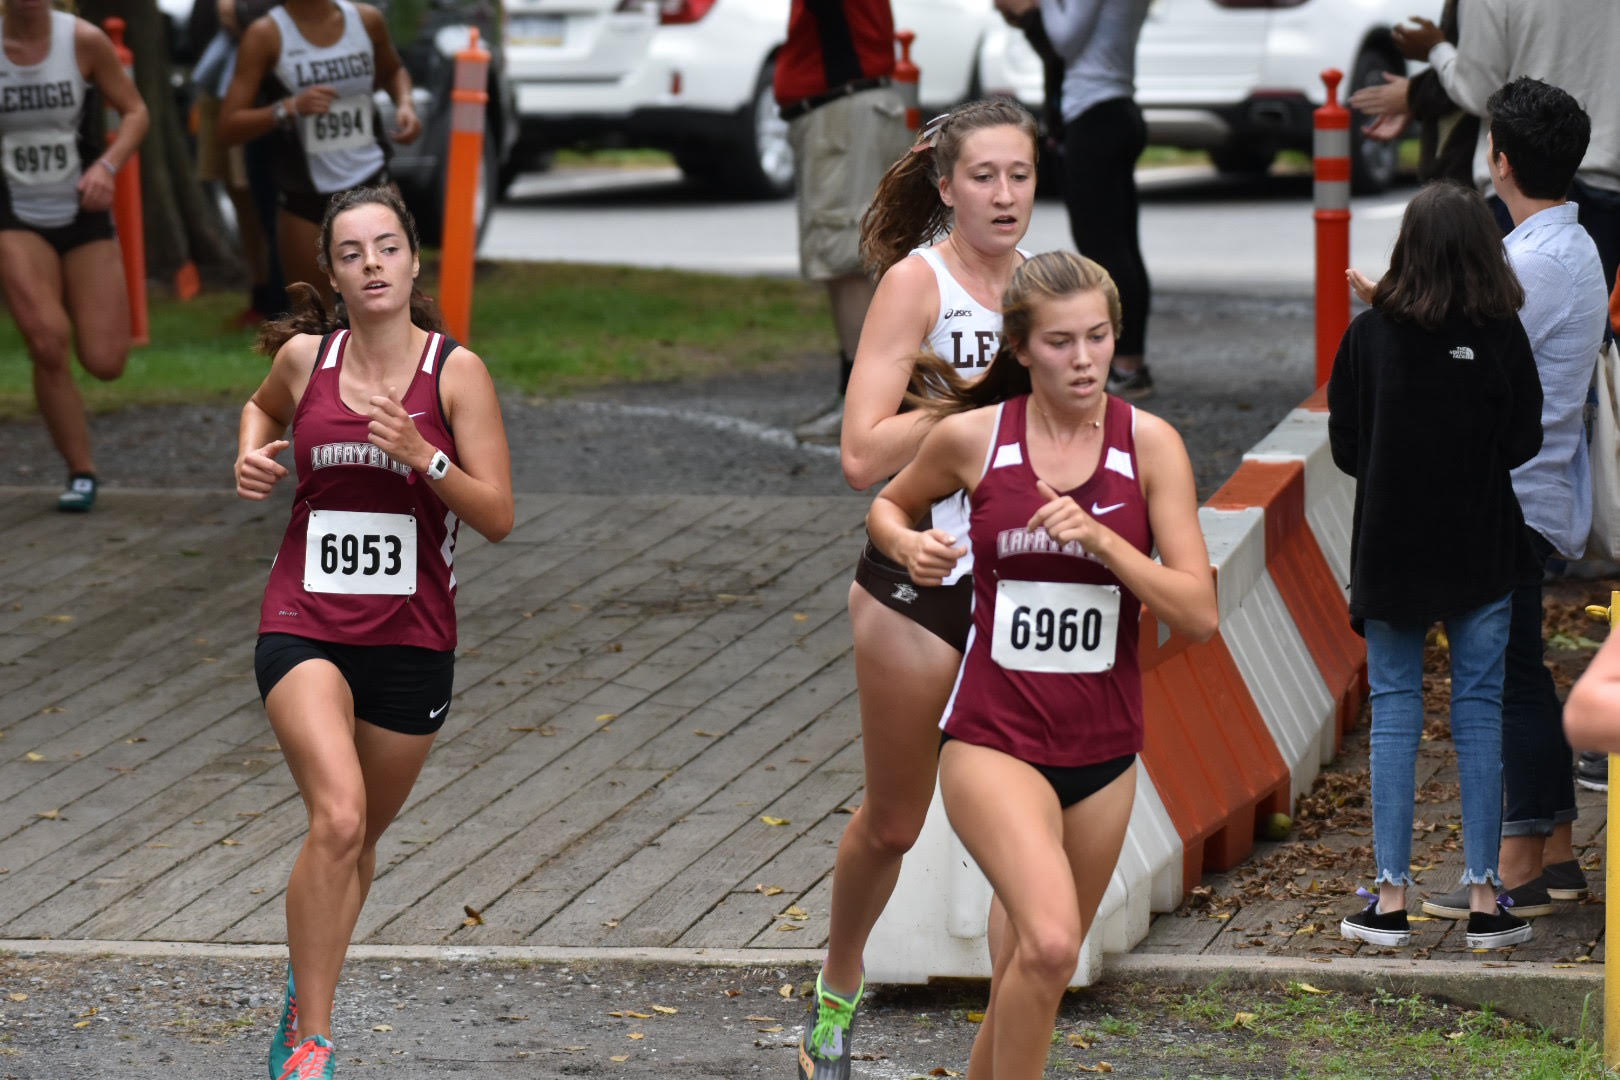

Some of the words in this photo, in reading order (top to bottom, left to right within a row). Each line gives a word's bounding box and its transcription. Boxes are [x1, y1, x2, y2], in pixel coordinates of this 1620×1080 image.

[295, 52, 371, 87] LEHIGH
[0, 81, 75, 112] EHIGH
[315, 108, 364, 140] 6994
[14, 144, 67, 172] 6979
[320, 533, 401, 575] 6953
[1011, 605, 1102, 652] 6960
